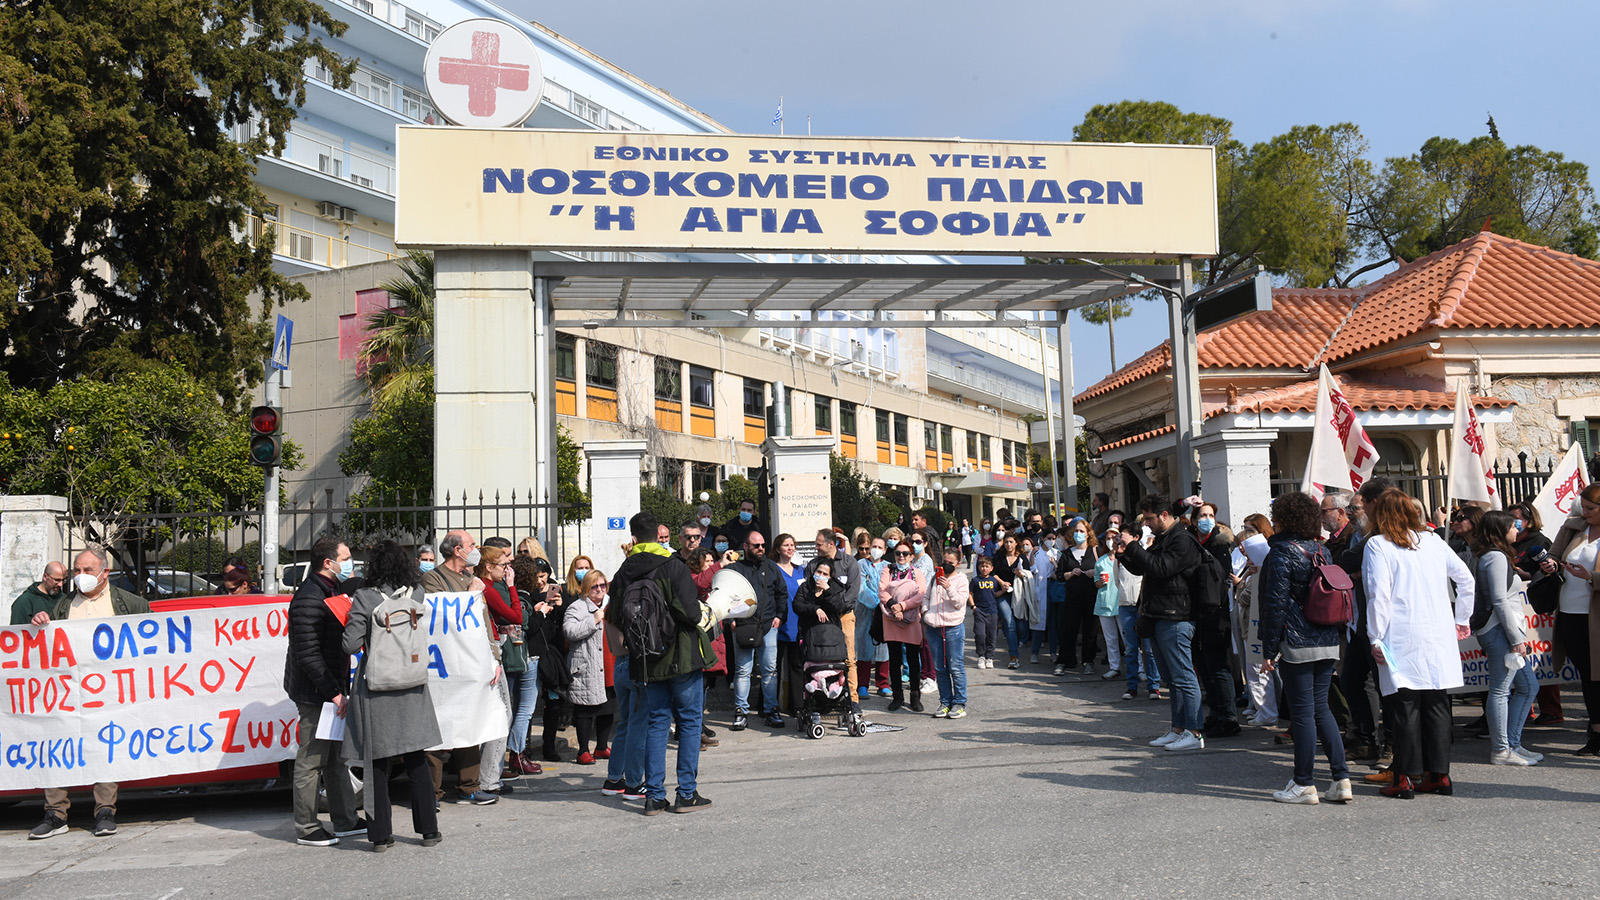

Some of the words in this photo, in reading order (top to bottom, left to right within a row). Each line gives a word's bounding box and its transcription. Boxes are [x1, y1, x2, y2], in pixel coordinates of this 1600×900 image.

[594, 146, 729, 162] ΕΘΝΙΚΟ
[748, 149, 916, 167] ΣΥΣΤΗΜΑ
[929, 153, 1046, 169] ΥΓΕΙΑΣ
[483, 168, 890, 200] ΝΟΣΟΚΟΜΕΙΟ
[927, 177, 1143, 205] ΠΑΙΔΩΝ
[679, 207, 823, 233] ΑΓΙΑ
[613, 519, 620, 528] 3
[92, 615, 193, 661] ΟΛΩΝ
[426, 595, 480, 636] ΥΜΑ
[6, 655, 256, 714] ΠΡΟΣΩΠΙΚΟΥ
[1464, 674, 1490, 685] ΖΩΓΡ
[218, 708, 300, 753] Ζωγ
